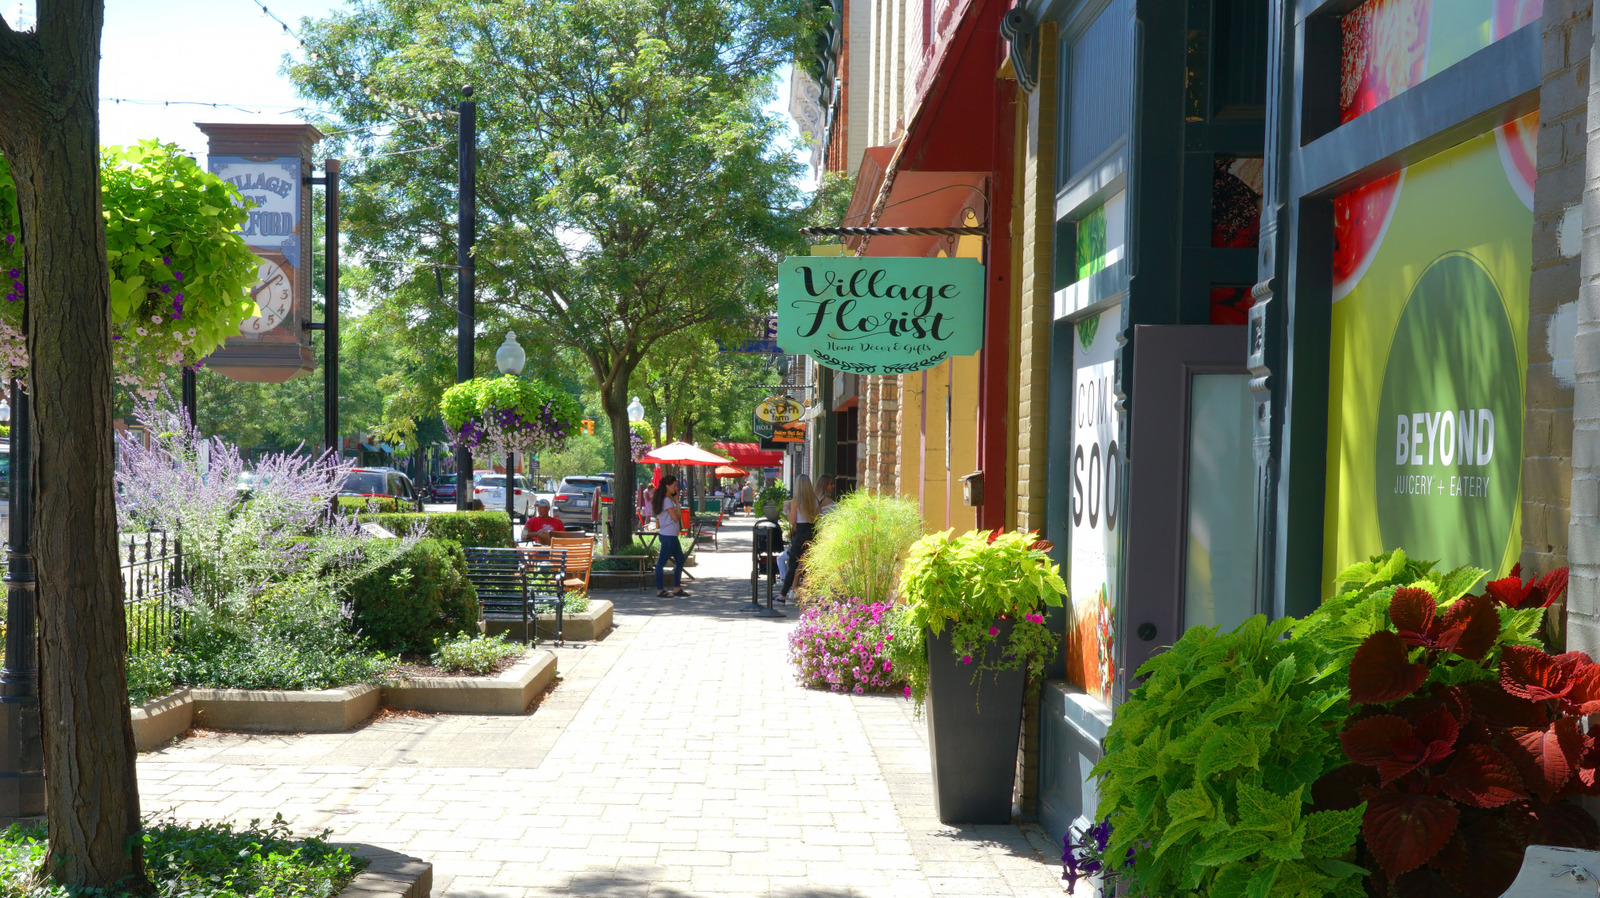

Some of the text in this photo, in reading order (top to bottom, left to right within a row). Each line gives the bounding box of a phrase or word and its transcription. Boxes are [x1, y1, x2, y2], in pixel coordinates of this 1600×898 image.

[224, 172, 293, 199] ILLAGE
[232, 211, 293, 237] LFORD
[794, 265, 961, 318] Village
[791, 298, 955, 341] Florist
[827, 341, 856, 351] Home
[893, 342, 901, 351] &
[903, 343, 931, 355] Gifts
[763, 403, 800, 415] acorn
[1078, 375, 1119, 429] COMI
[1395, 408, 1495, 467] BEYOND
[1072, 439, 1119, 532] SOO
[1394, 475, 1434, 496] JUICERY
[1449, 476, 1491, 498] EATERY
